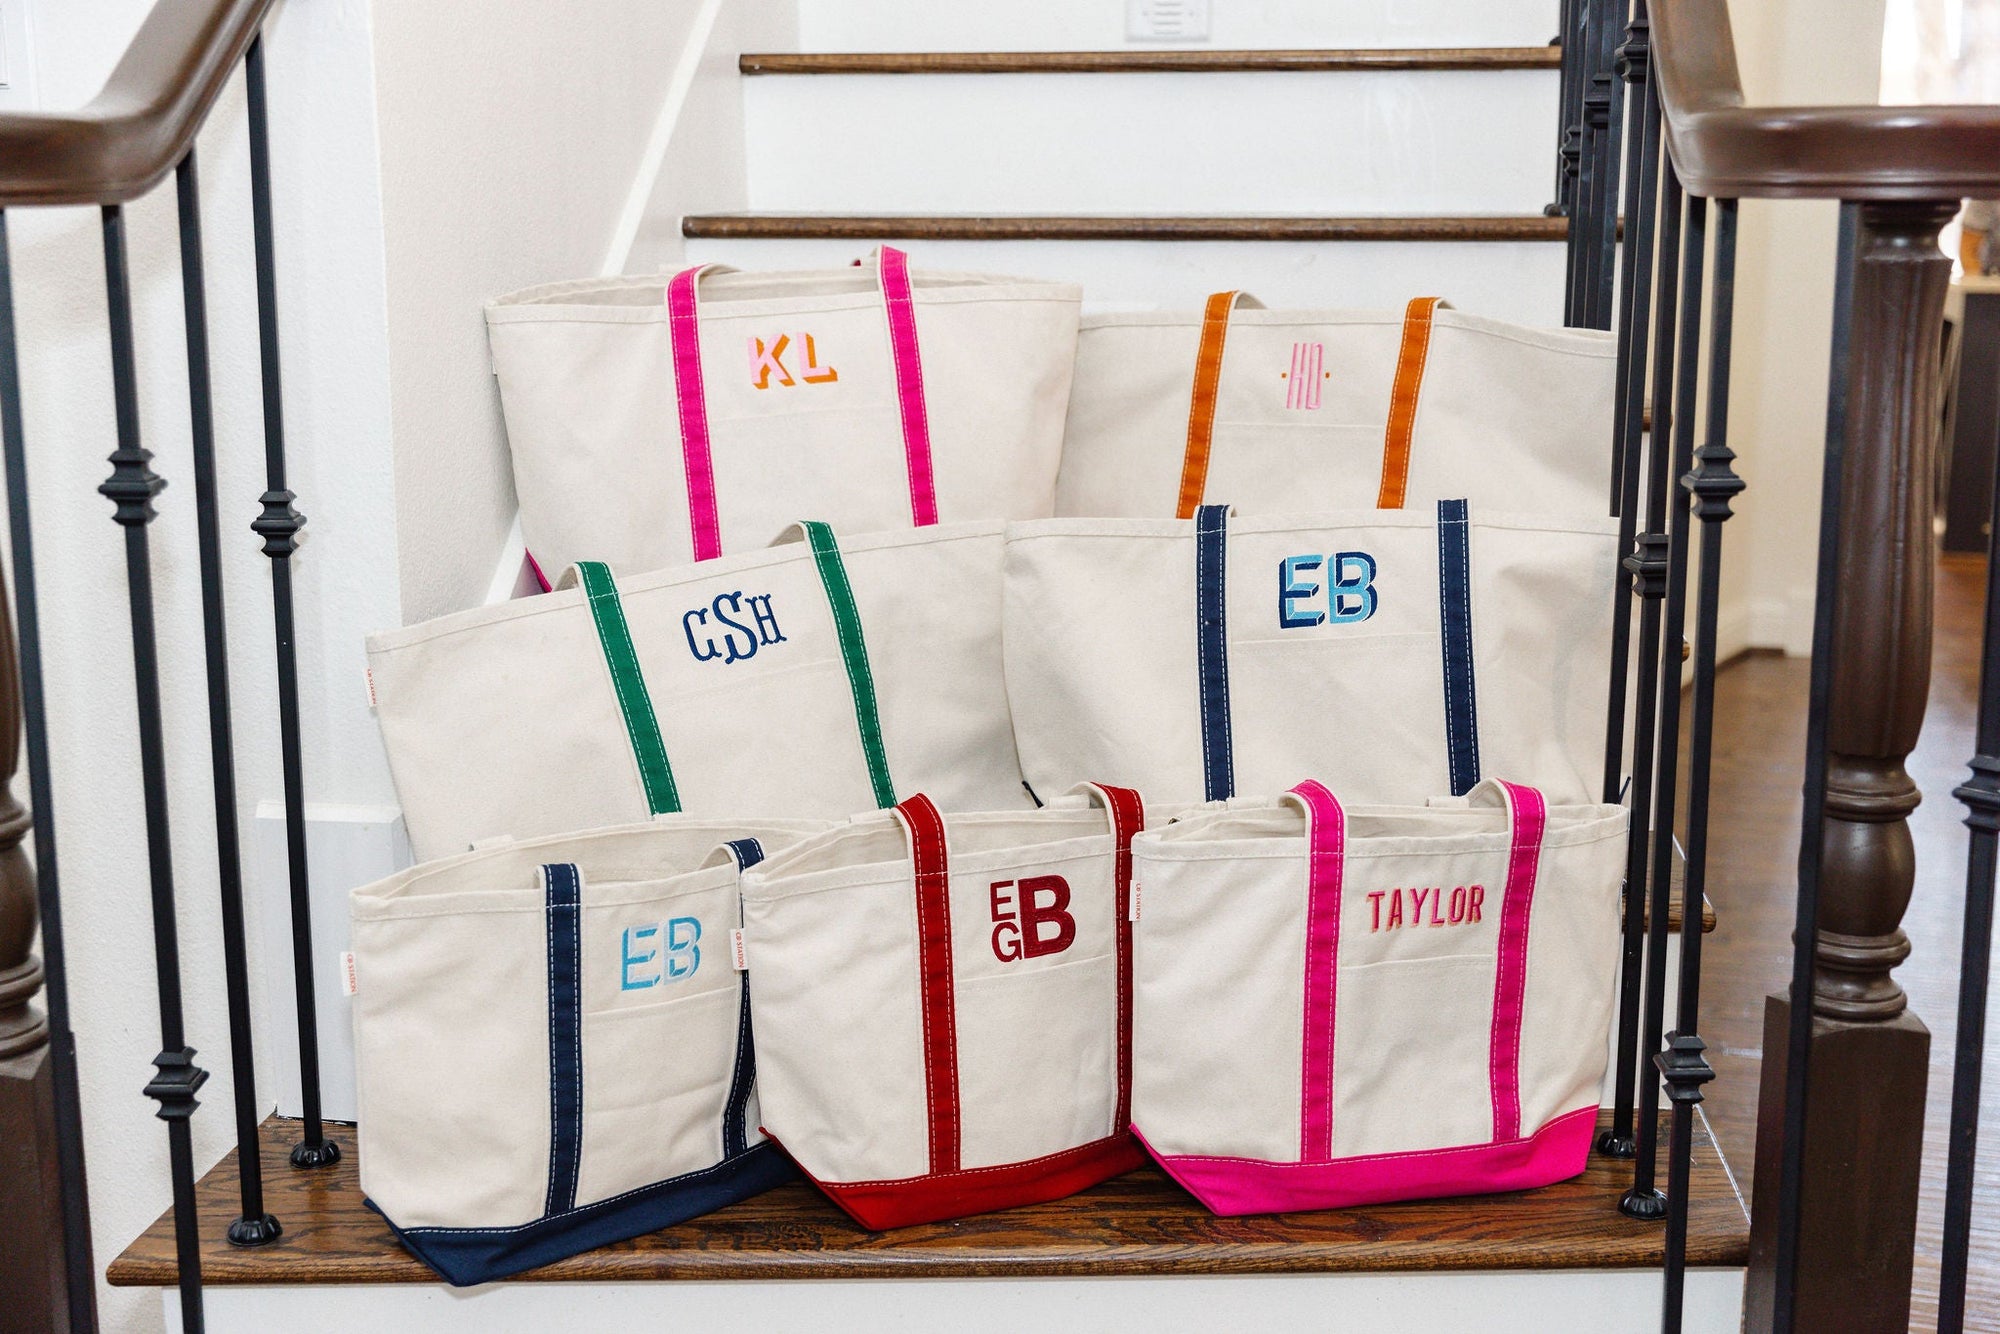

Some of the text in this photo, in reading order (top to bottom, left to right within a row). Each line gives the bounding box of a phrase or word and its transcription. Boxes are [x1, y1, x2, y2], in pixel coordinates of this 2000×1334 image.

[747, 332, 838, 390] KL
[1279, 552, 1378, 629] EB
[683, 591, 787, 665] CSH
[1366, 884, 1485, 933] TAYLOR
[621, 917, 702, 991] EB
[736, 942, 745, 968] STATION
